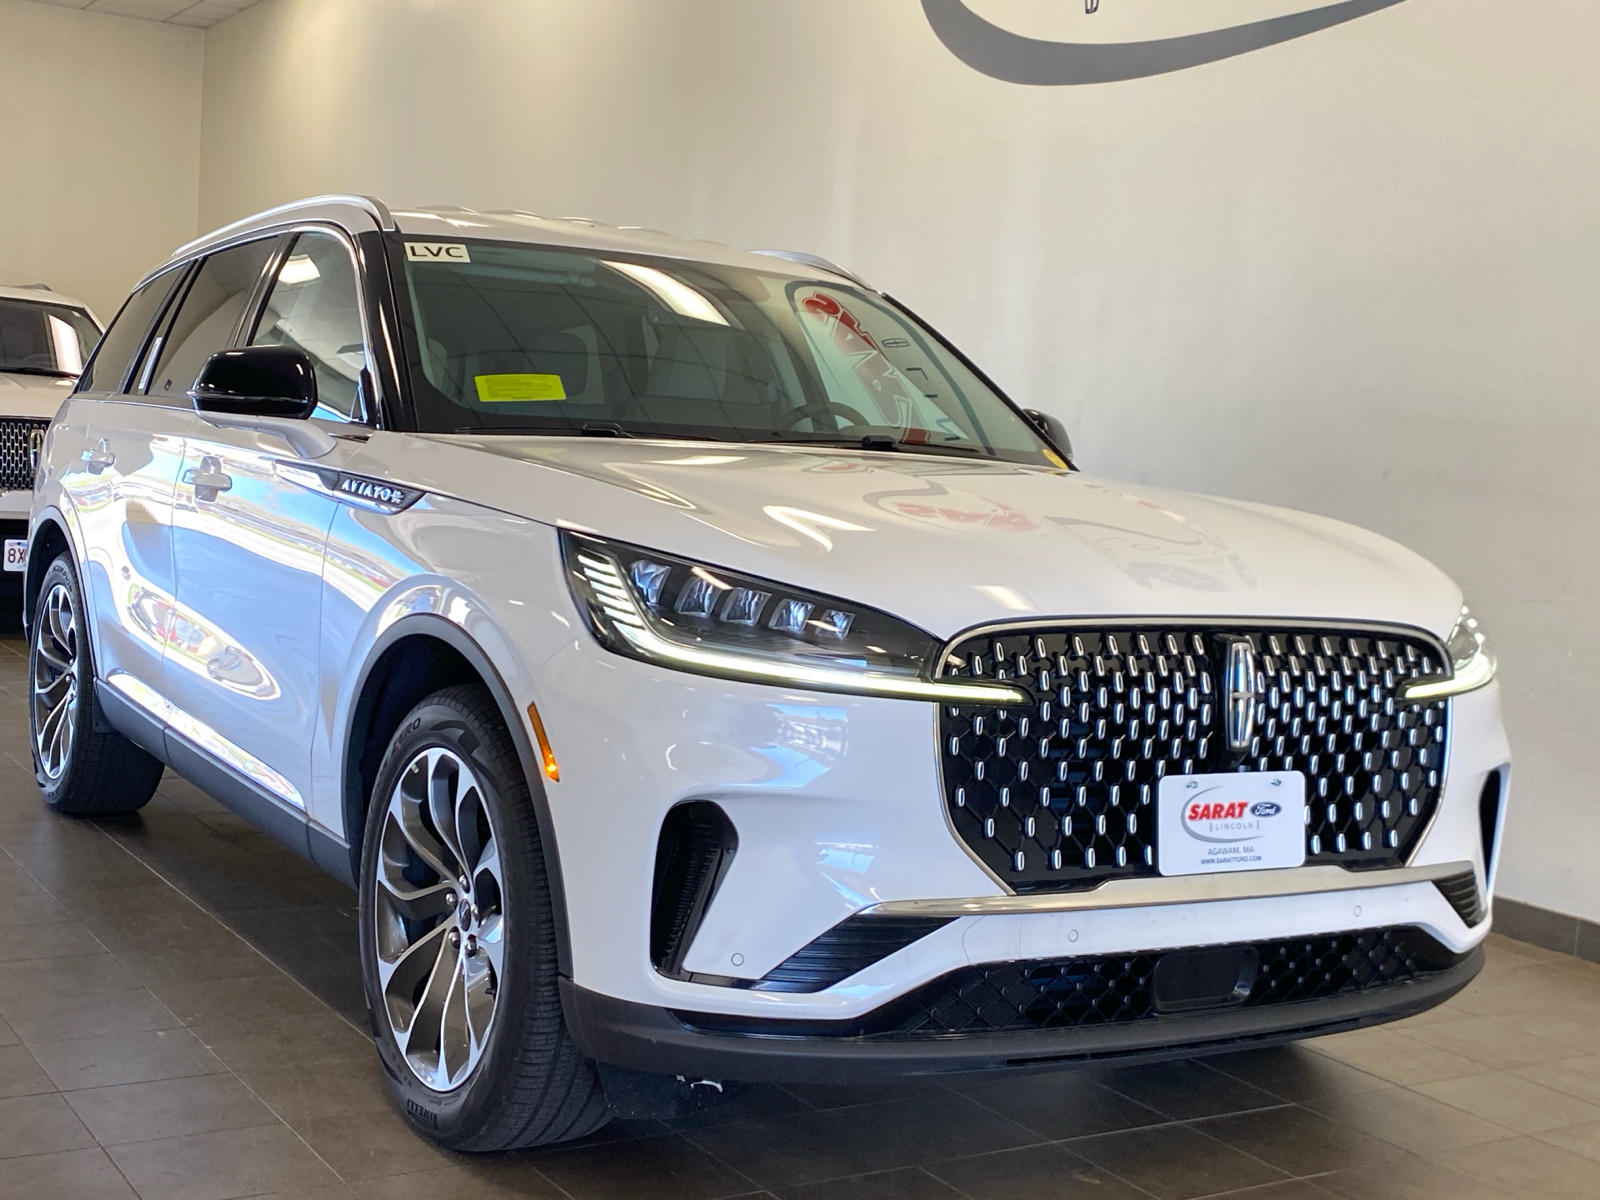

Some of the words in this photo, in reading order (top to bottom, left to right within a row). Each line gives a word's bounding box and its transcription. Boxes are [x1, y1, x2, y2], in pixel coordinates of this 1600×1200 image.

[409, 245, 464, 258] LVC
[341, 478, 404, 504] AVIATOR
[1188, 801, 1249, 820] SARAT
[1254, 803, 1277, 815] Ford
[1215, 822, 1254, 831] LINCOLN
[1207, 846, 1241, 856] AGAWAM,
[1200, 855, 1261, 864] WWW.SARATFORD.COM
